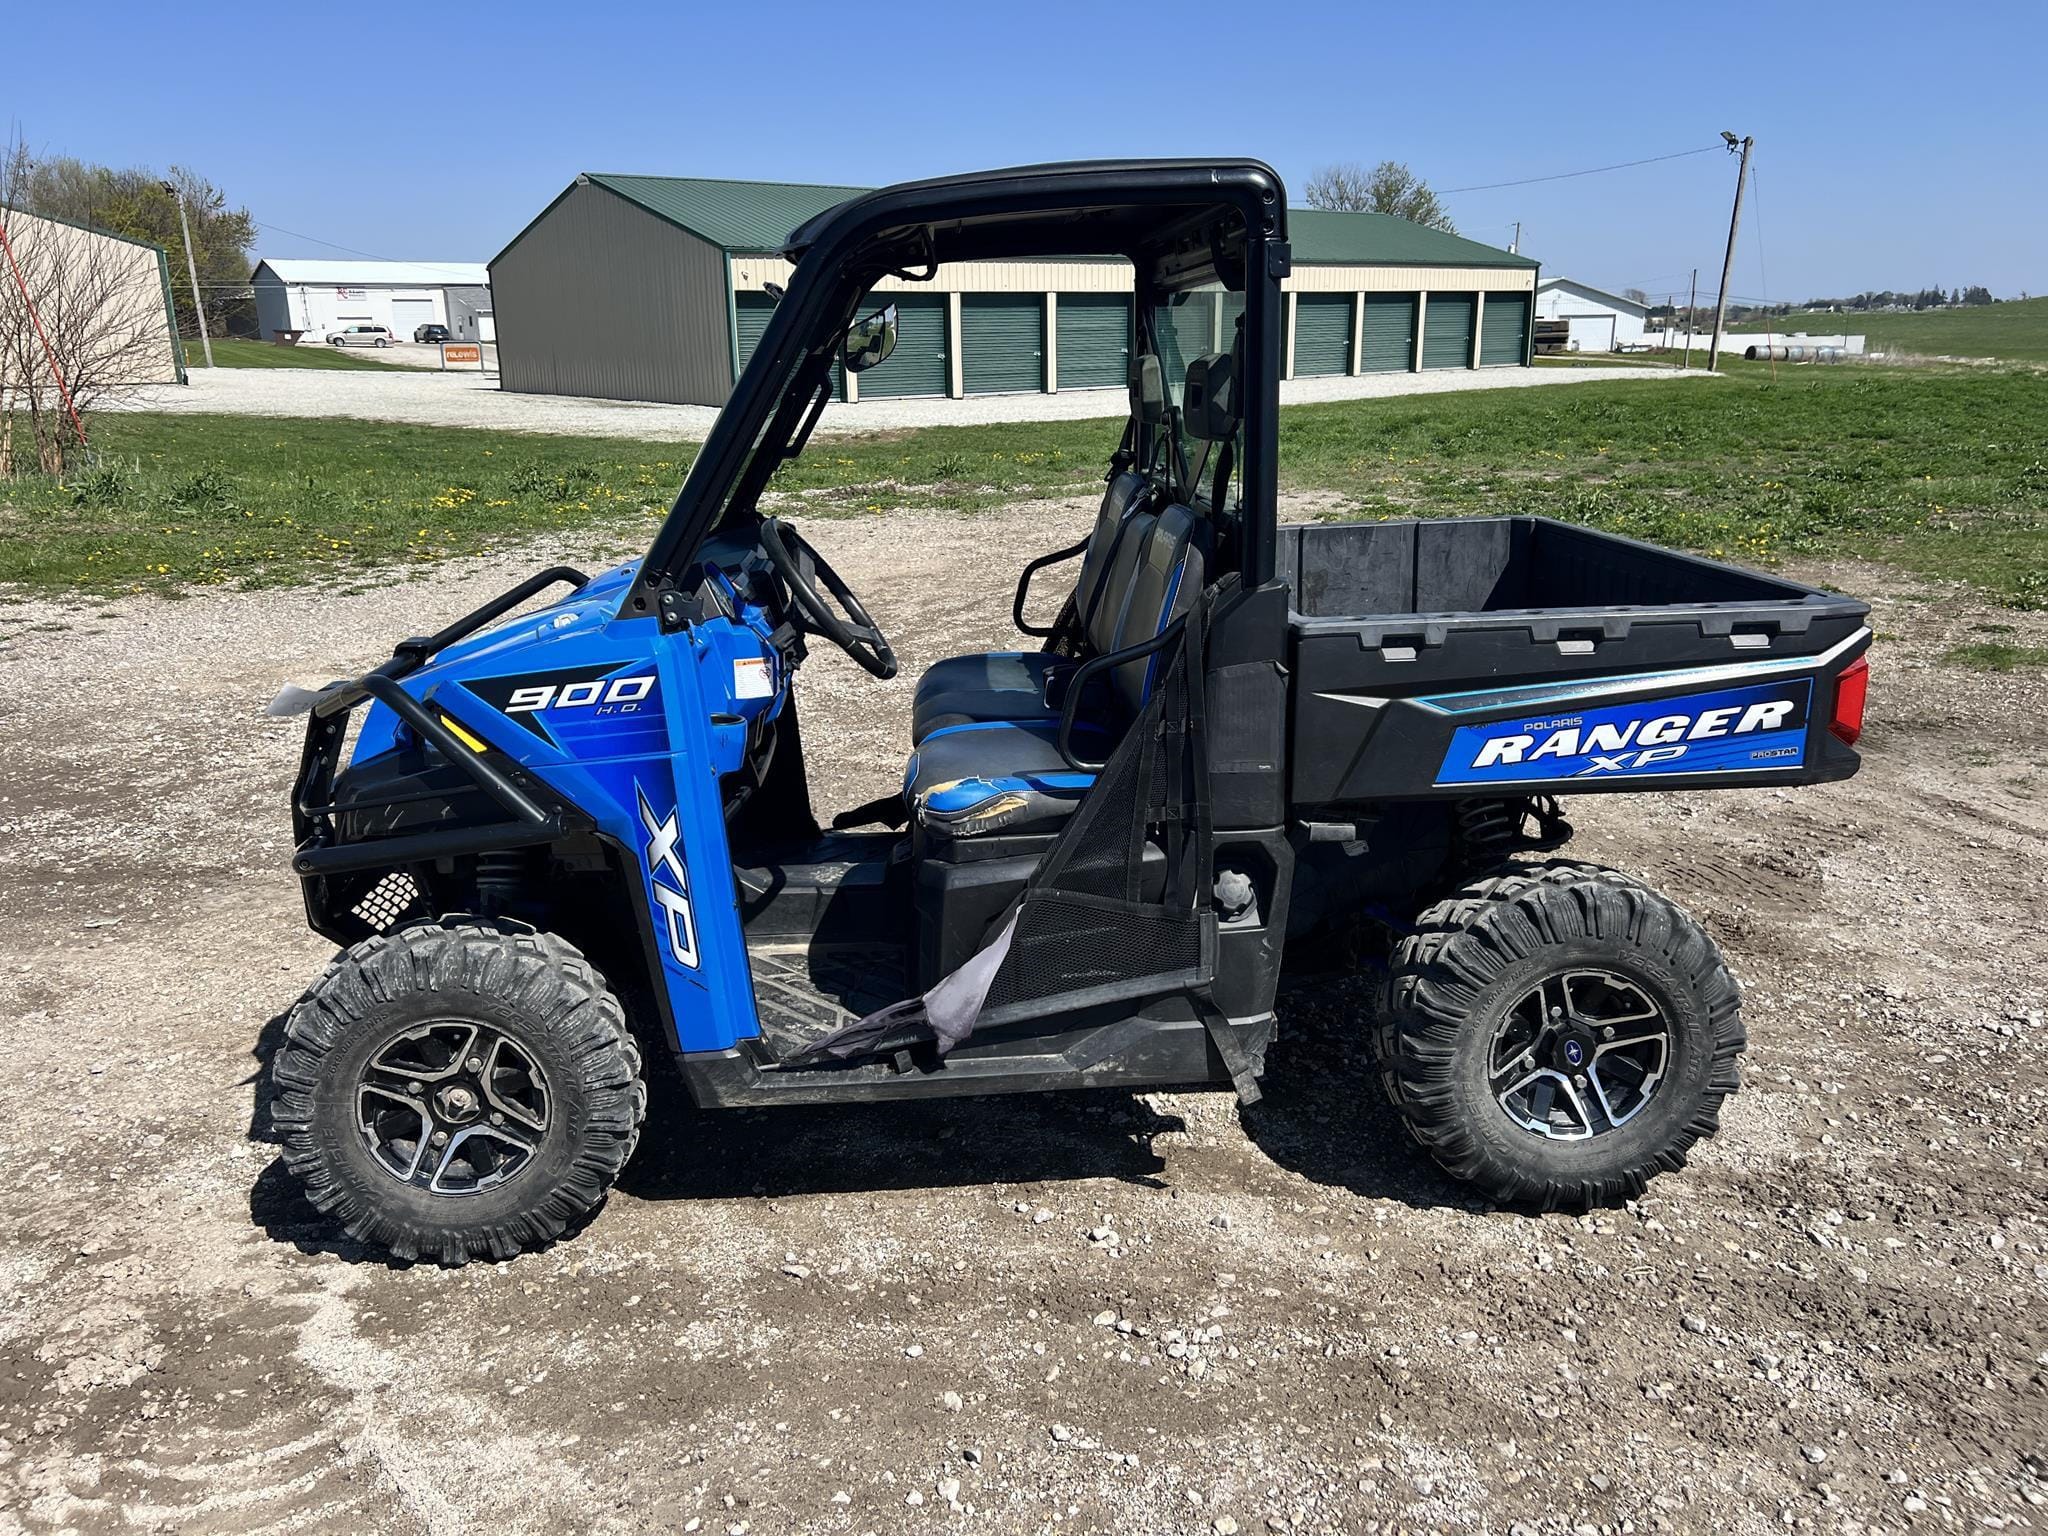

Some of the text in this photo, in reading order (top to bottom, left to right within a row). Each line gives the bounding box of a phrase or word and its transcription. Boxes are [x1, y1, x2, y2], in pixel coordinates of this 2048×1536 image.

[504, 676, 656, 713] 900
[596, 703, 642, 715] H.O.
[1472, 700, 1794, 768] RANGER
[1523, 716, 1583, 732] POLARIS
[1569, 745, 1689, 776] XP
[1752, 746, 1799, 760] PROSTAR
[636, 785, 701, 970] XP
